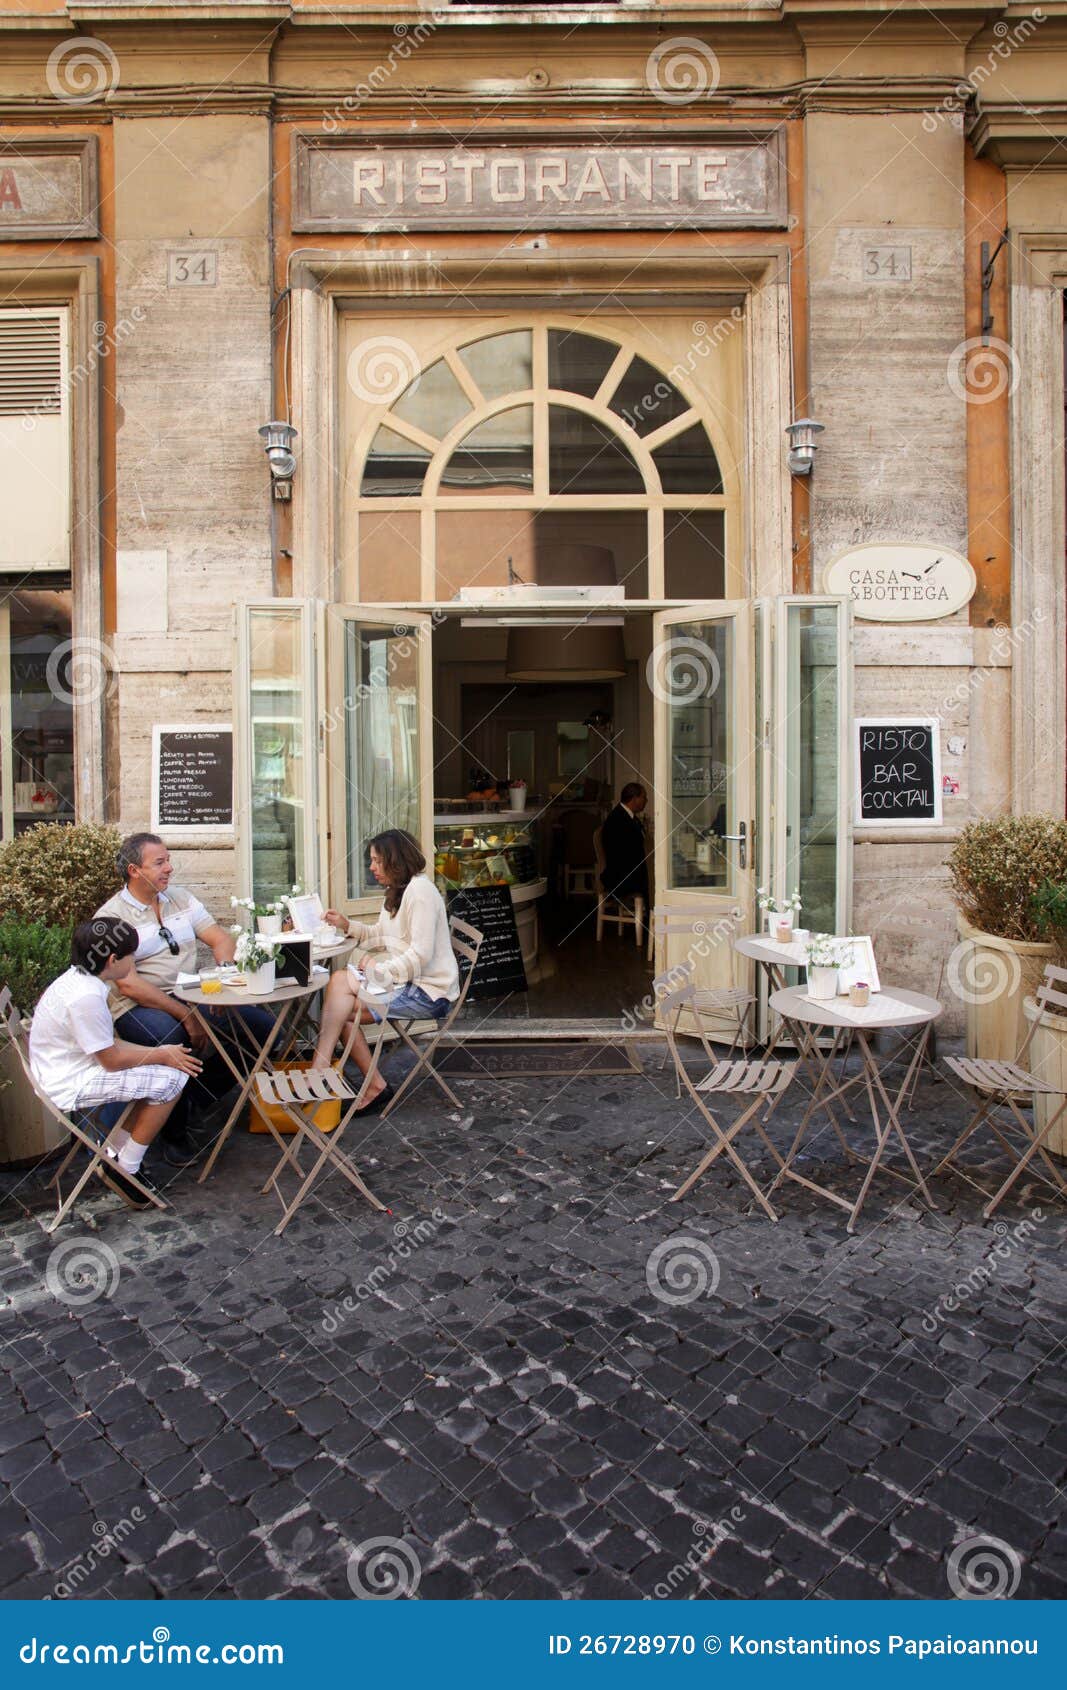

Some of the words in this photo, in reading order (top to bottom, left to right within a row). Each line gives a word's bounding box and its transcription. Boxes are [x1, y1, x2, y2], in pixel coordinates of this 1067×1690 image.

[353, 156, 728, 204] RISTORANTE
[175, 257, 209, 281] 34
[849, 570, 899, 584] CASA
[863, 729, 927, 752] RISTO
[873, 763, 921, 784] BAR
[862, 790, 934, 809] COCKTAIL
